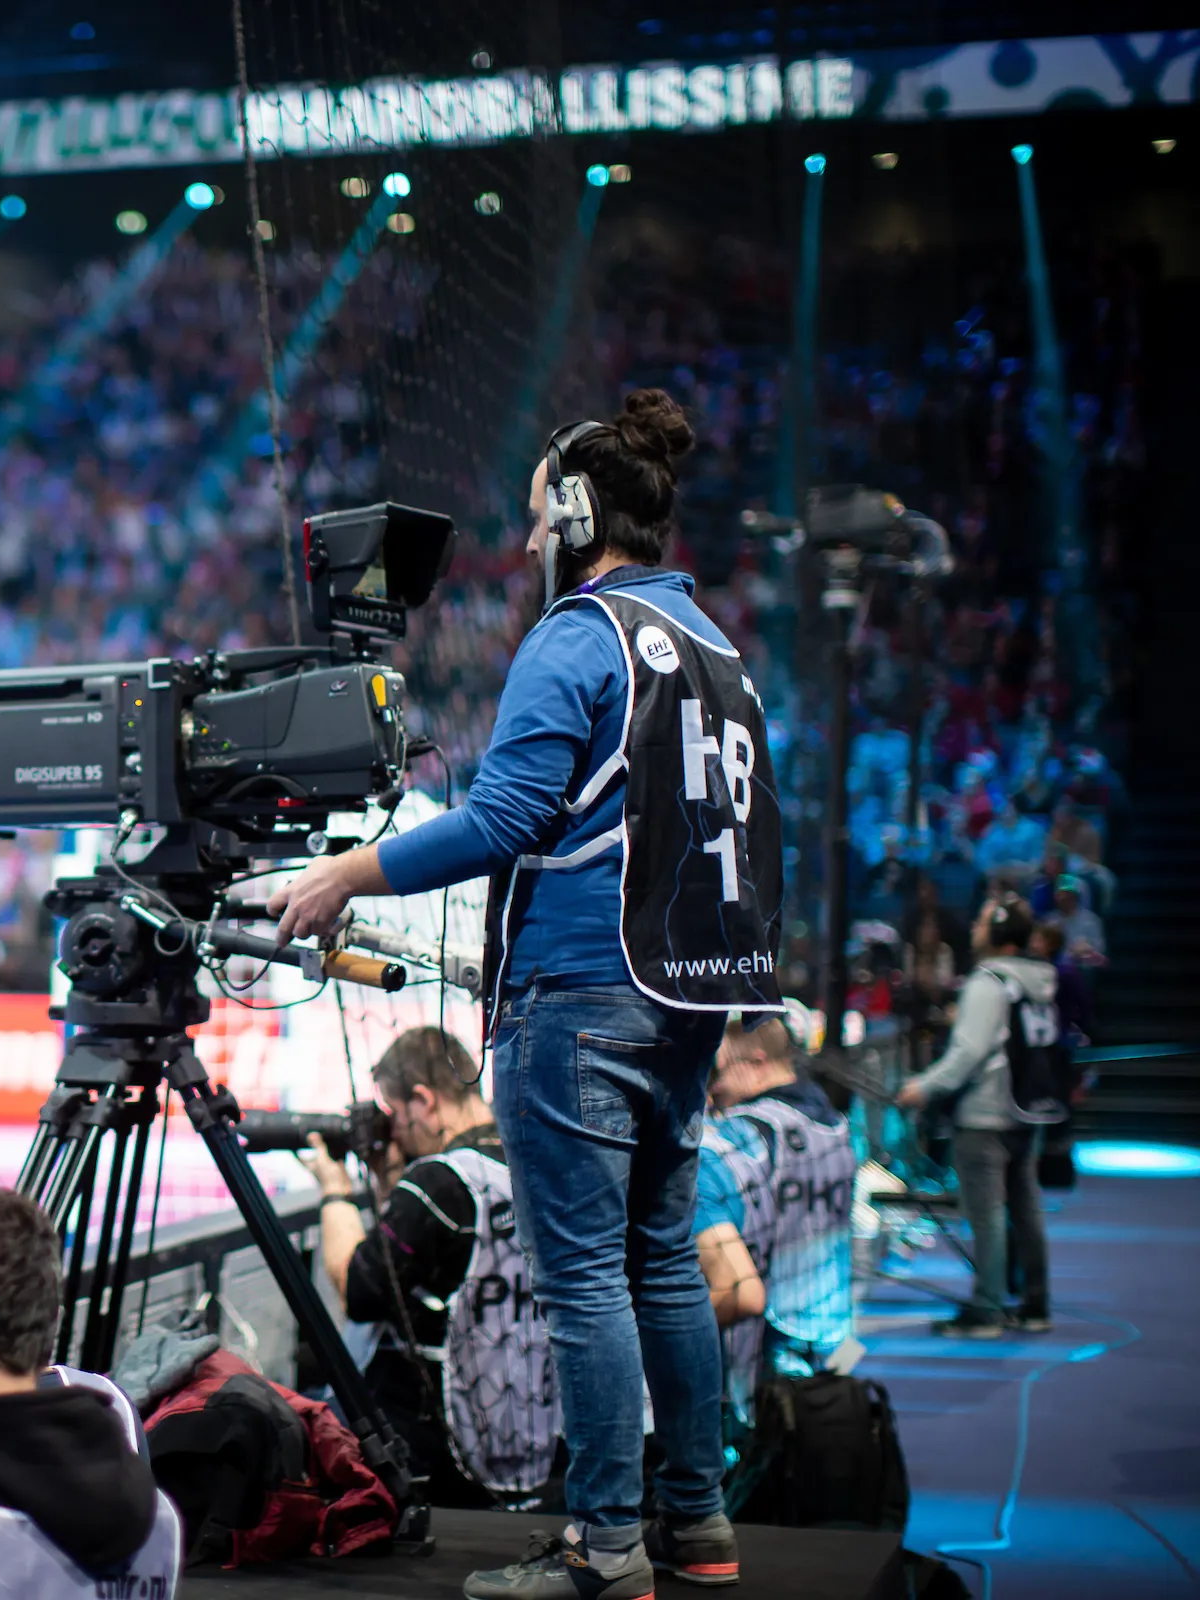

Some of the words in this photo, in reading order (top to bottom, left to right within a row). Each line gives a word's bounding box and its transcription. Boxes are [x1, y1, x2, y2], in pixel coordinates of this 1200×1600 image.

[646, 638, 668, 656] EHF
[15, 765, 83, 784] DIGISUPER
[84, 764, 103, 781] 95
[474, 1273, 539, 1325] PH
